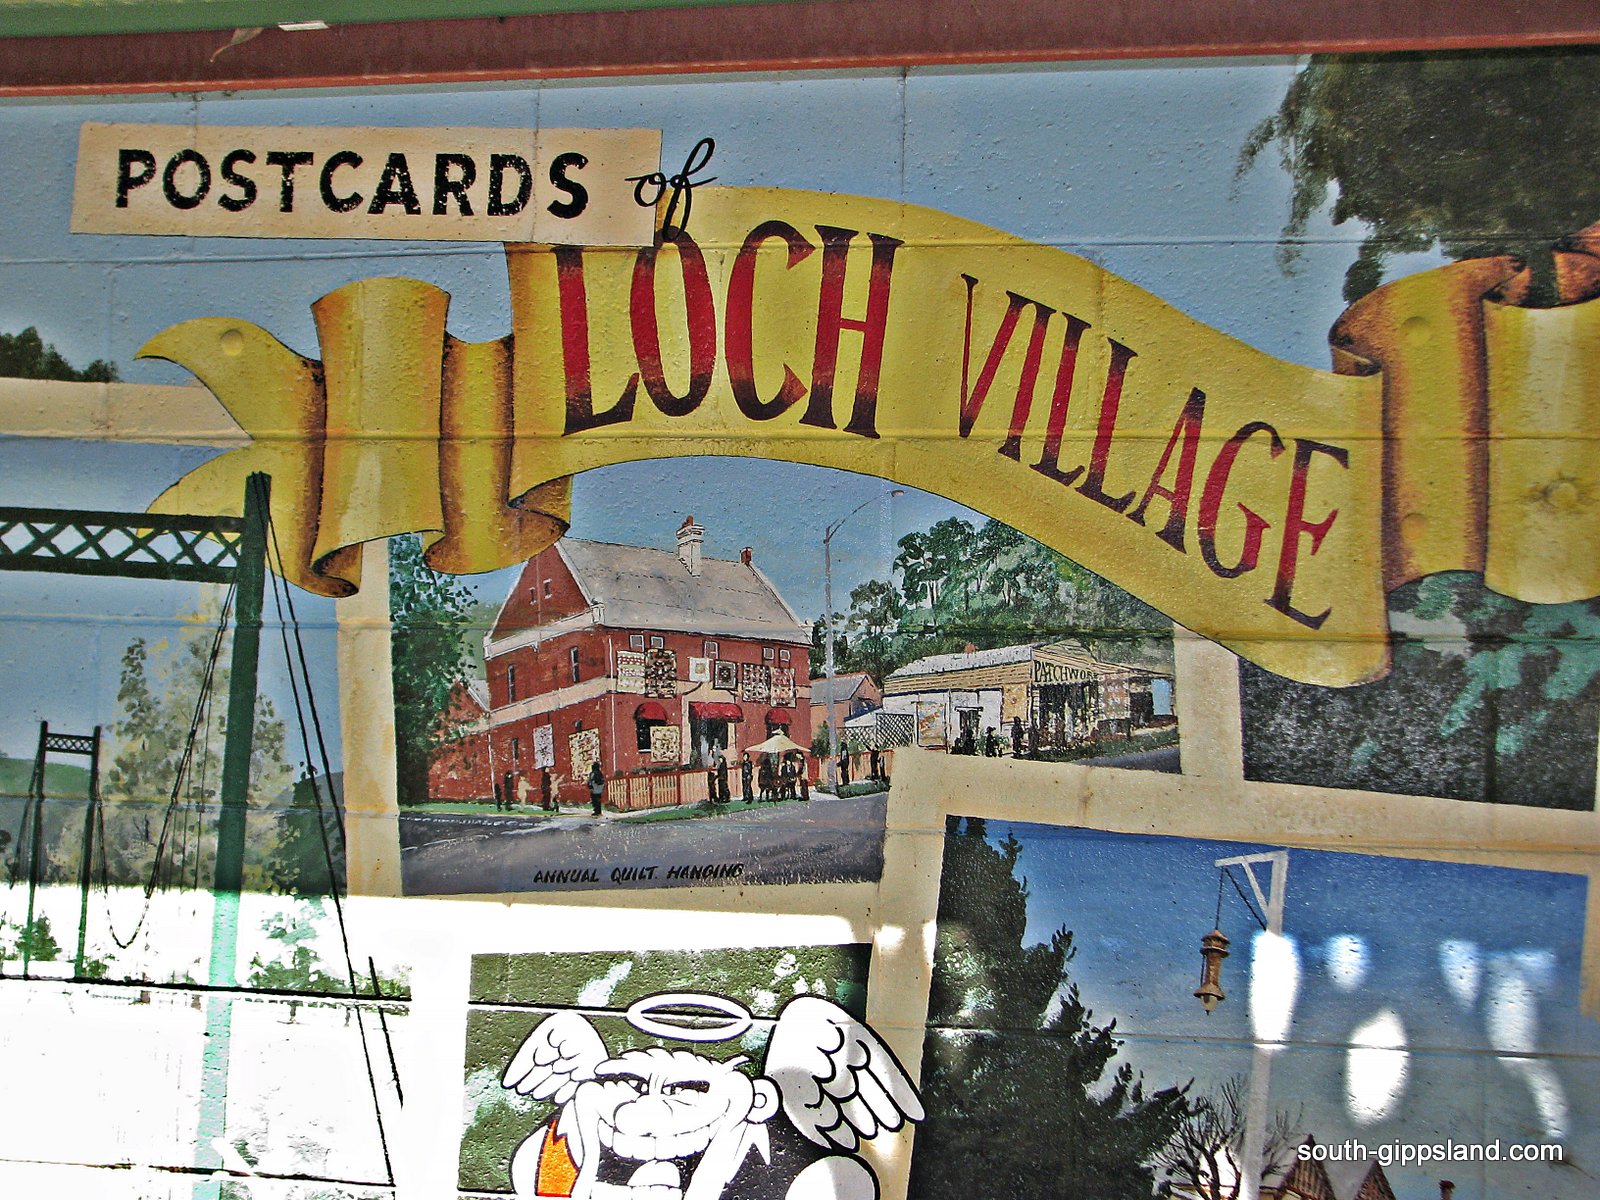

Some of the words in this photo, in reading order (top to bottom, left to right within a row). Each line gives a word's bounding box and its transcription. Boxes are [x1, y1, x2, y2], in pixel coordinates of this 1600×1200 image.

[115, 147, 589, 219] POSTCARDS
[624, 137, 718, 242] of
[550, 220, 905, 438] LOCH
[959, 272, 1350, 630] VILLAGE
[532, 868, 600, 884] ANNUAL
[666, 863, 745, 881] HANGING
